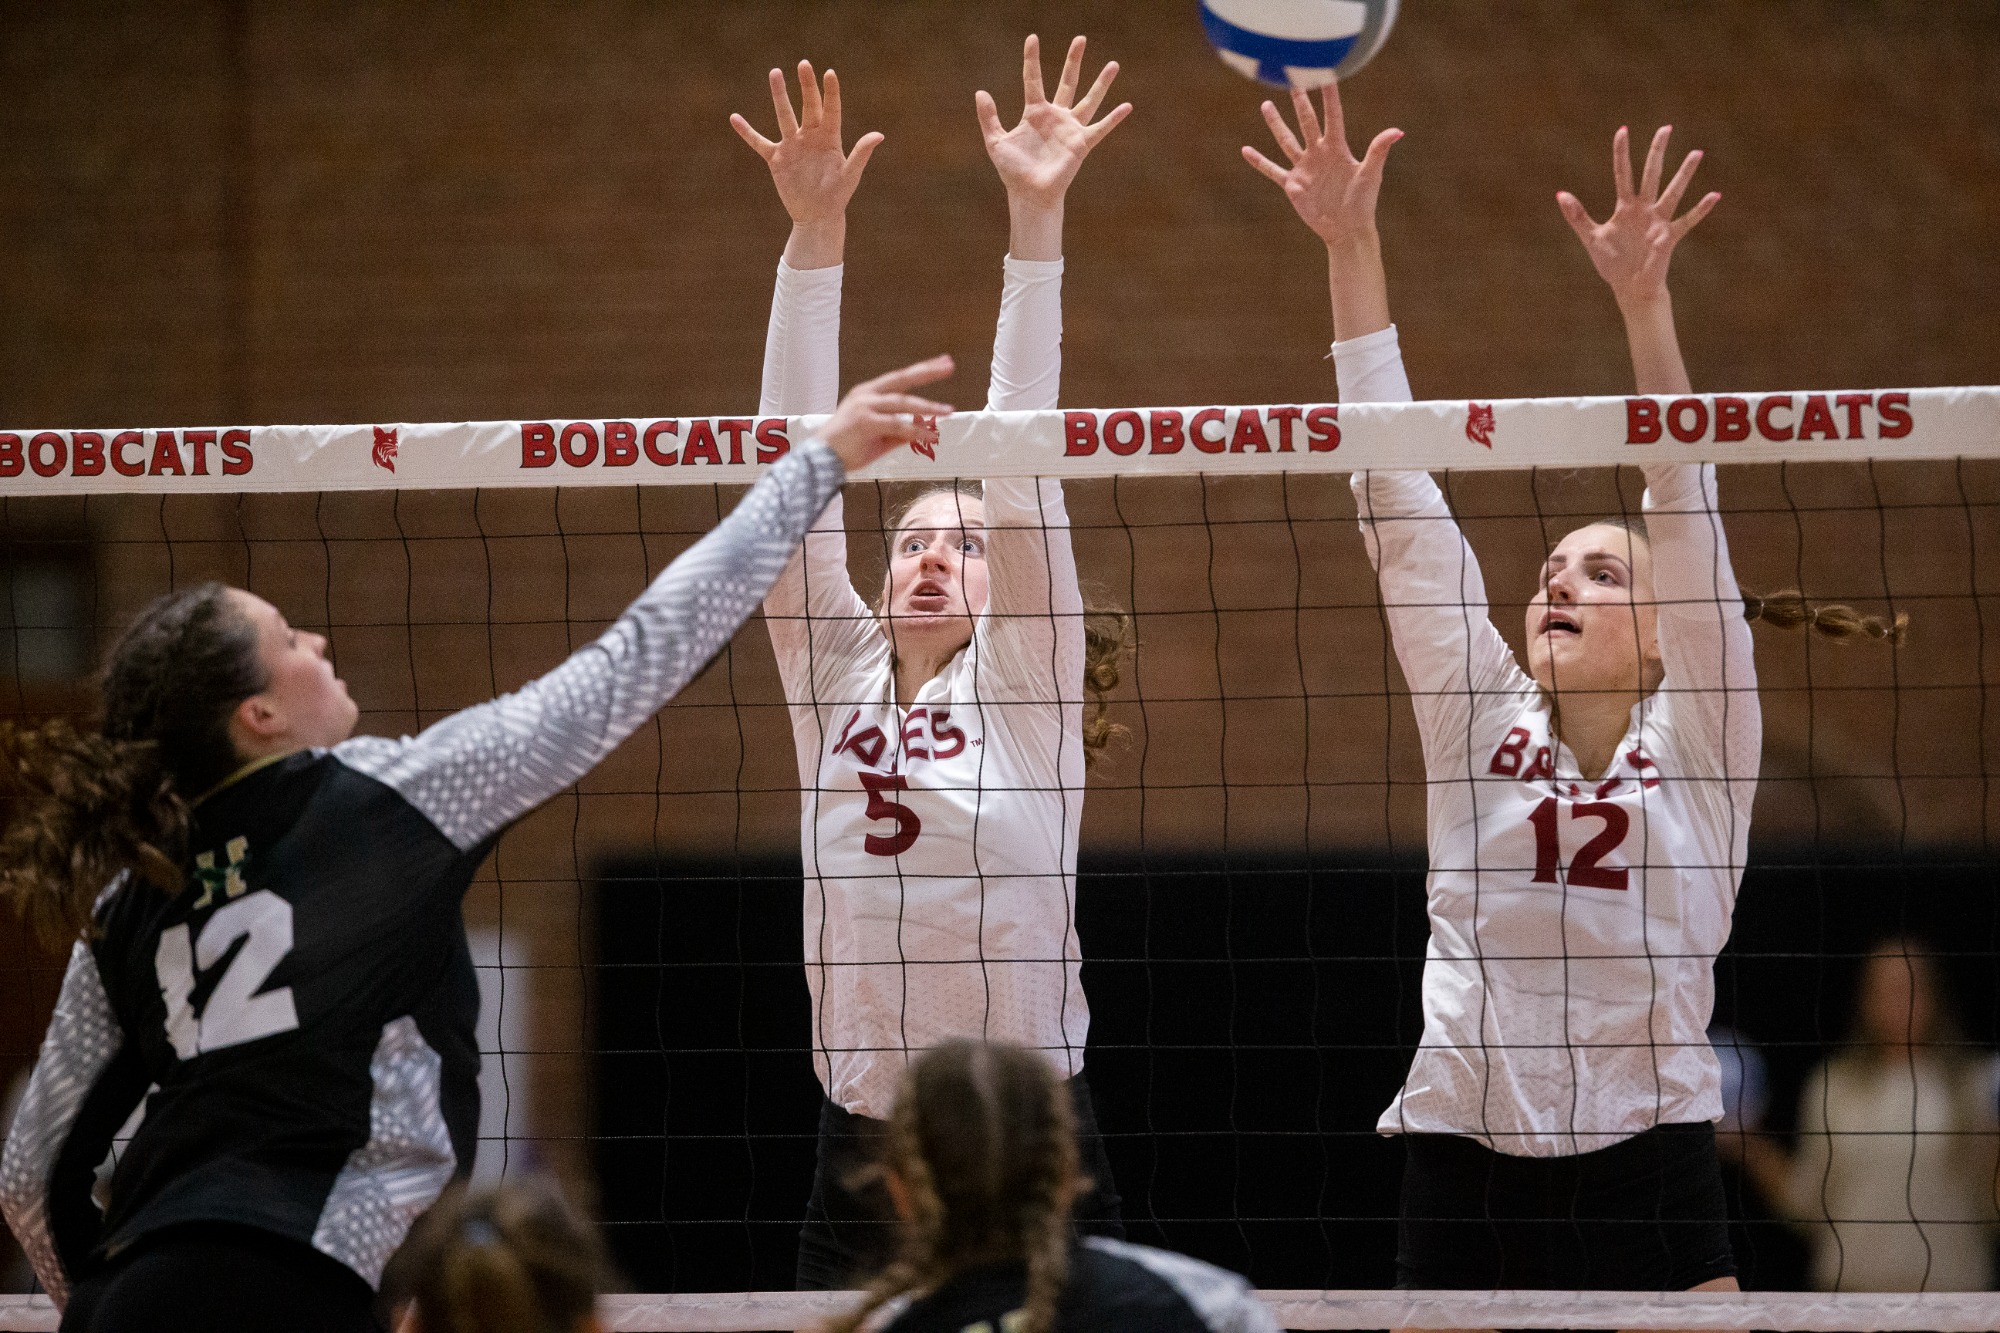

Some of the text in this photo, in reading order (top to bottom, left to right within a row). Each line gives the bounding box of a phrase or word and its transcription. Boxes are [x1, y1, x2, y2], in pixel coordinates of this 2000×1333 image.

[519, 418, 791, 468] BOBCATS
[1062, 405, 1342, 457] BOBCATS
[1625, 393, 1914, 444] BOBCATS
[0, 429, 253, 477] BOBCATS
[832, 708, 966, 775] AES
[1488, 726, 1662, 800] BAS
[858, 771, 922, 857] 5
[1527, 796, 1630, 891] 12
[154, 888, 300, 1062] 12
